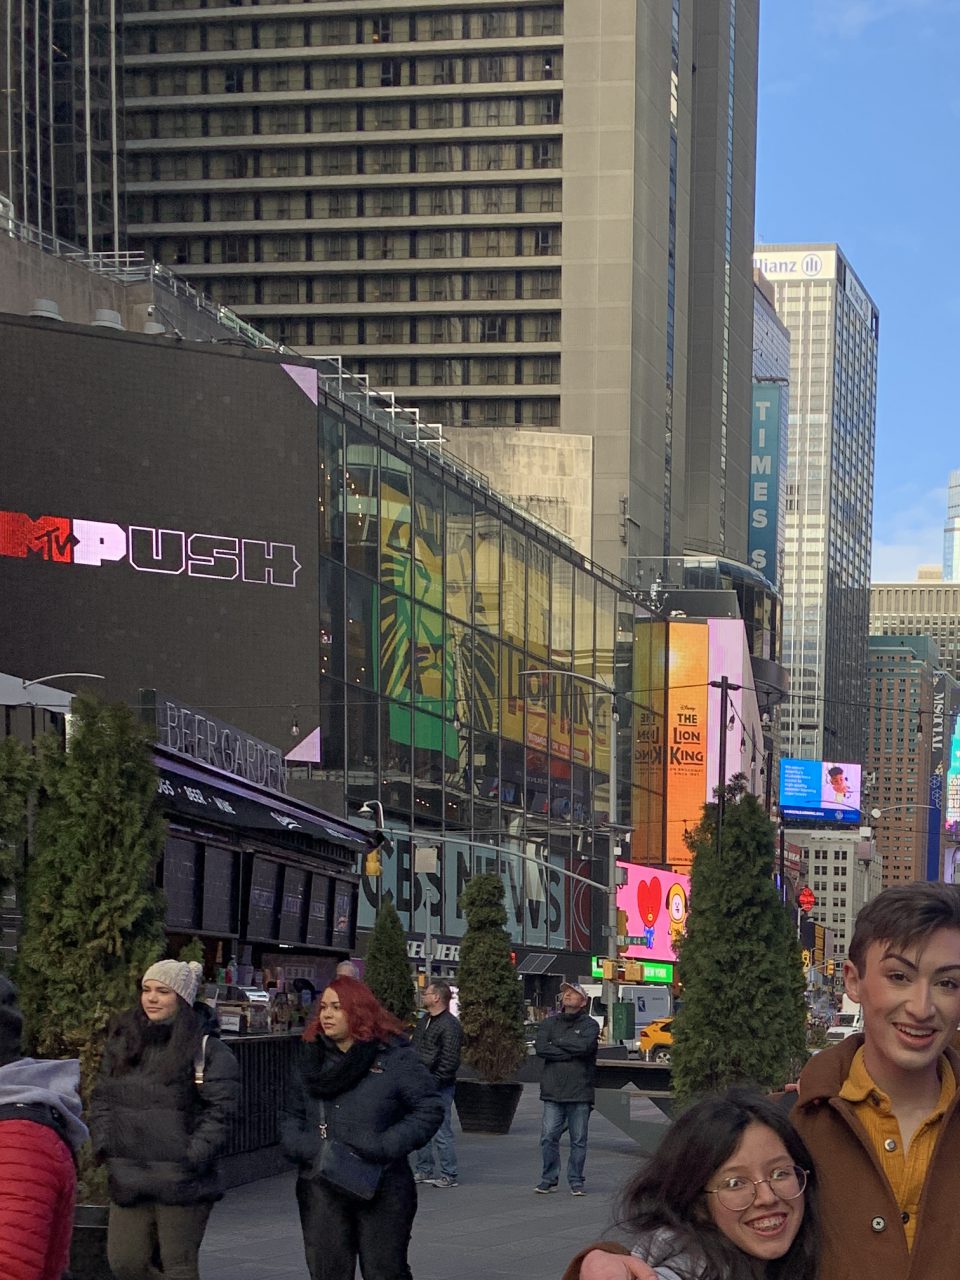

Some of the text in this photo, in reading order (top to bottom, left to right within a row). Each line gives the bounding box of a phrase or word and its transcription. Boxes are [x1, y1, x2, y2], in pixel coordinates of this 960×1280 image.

[750, 401, 772, 529] TIMES
[73, 517, 302, 588] PUSH
[673, 727, 701, 745] LION
[677, 713, 698, 724] THE
[669, 746, 704, 766] KING
[456, 849, 562, 933] NWS
